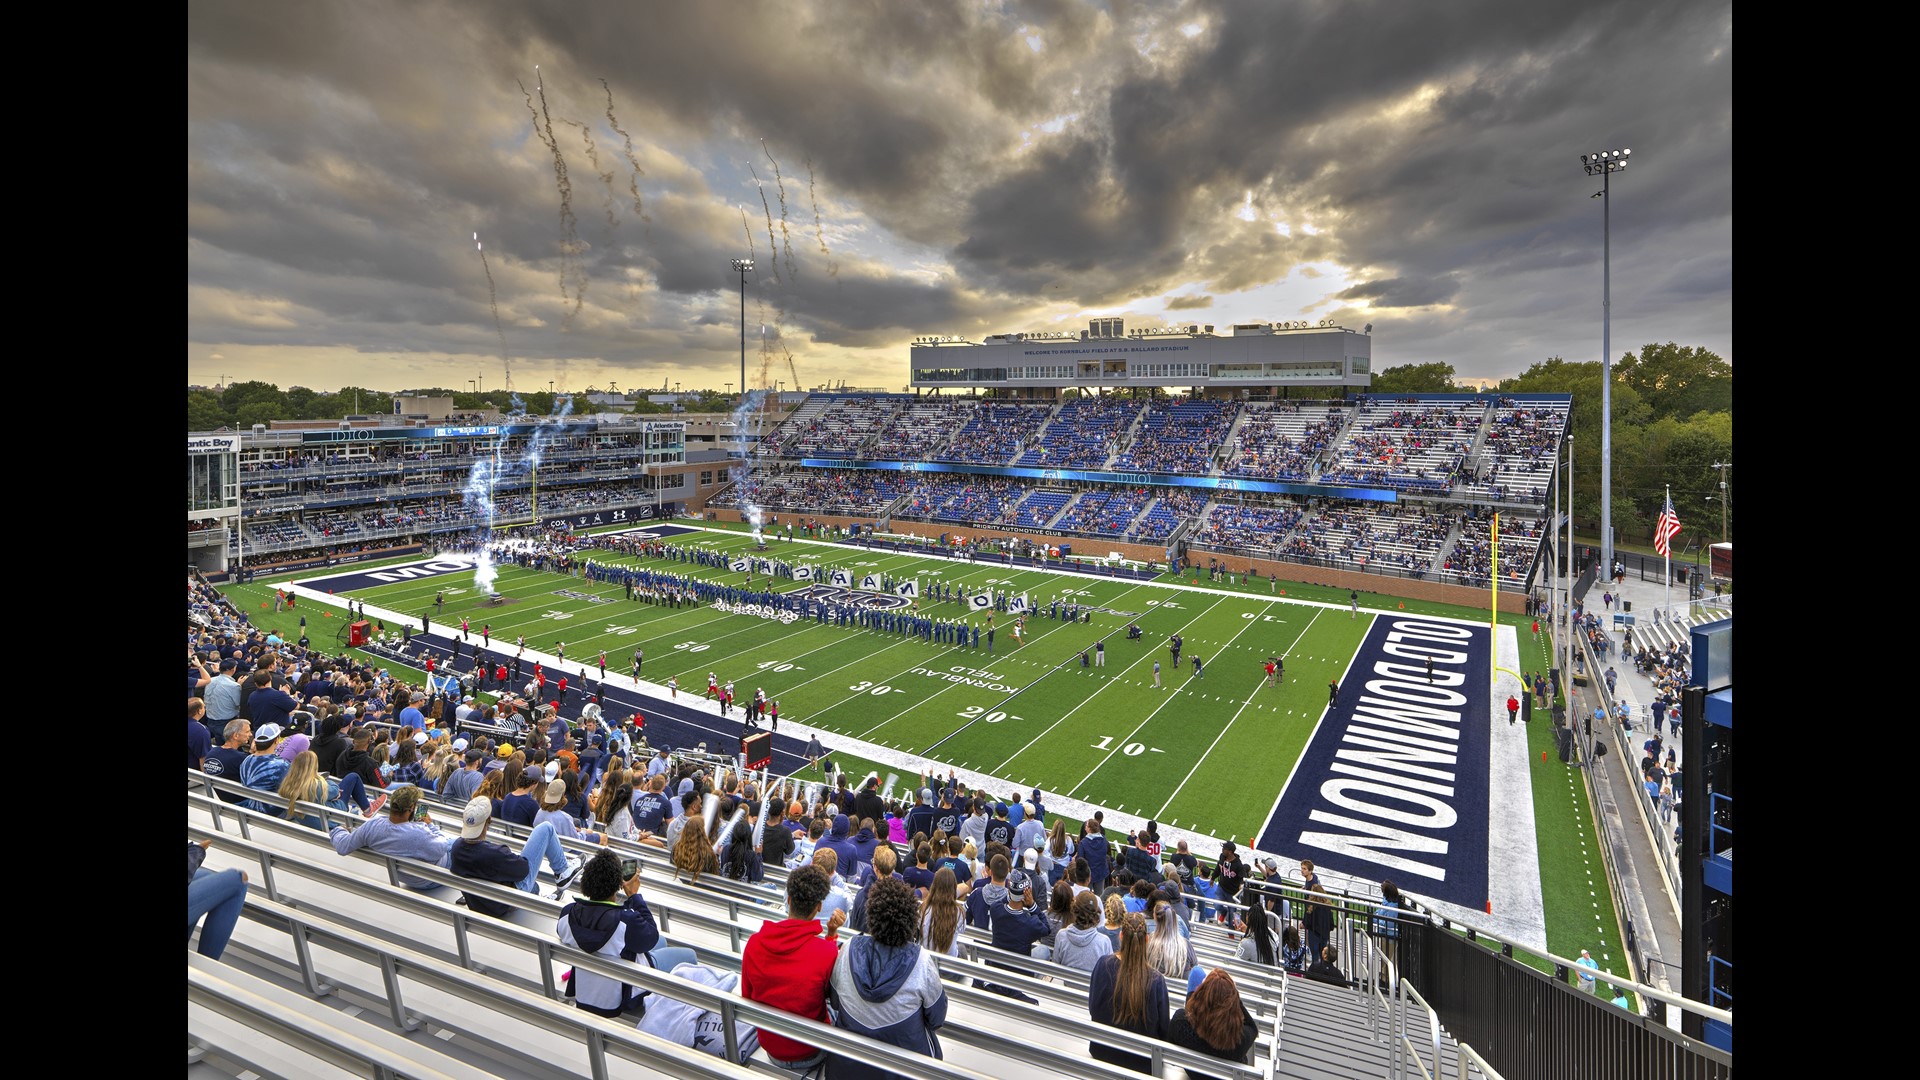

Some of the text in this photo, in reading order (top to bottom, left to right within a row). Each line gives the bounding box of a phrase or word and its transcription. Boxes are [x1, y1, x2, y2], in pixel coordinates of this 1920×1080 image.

[213, 438, 233, 447] Bay
[550, 519, 566, 528] COX
[1001, 527, 1044, 535] AUTOMOTIVE
[673, 641, 710, 653] 50
[1382, 620, 1474, 664] OLD
[756, 660, 794, 673] 40
[949, 665, 1006, 681] FIELD
[849, 680, 892, 696] 30
[910, 667, 1023, 693] KORNBLAU
[956, 706, 1007, 723] 20
[1090, 735, 1146, 756] 10
[1298, 661, 1467, 882] DOMINION
[1146, 843, 1161, 855] 50
